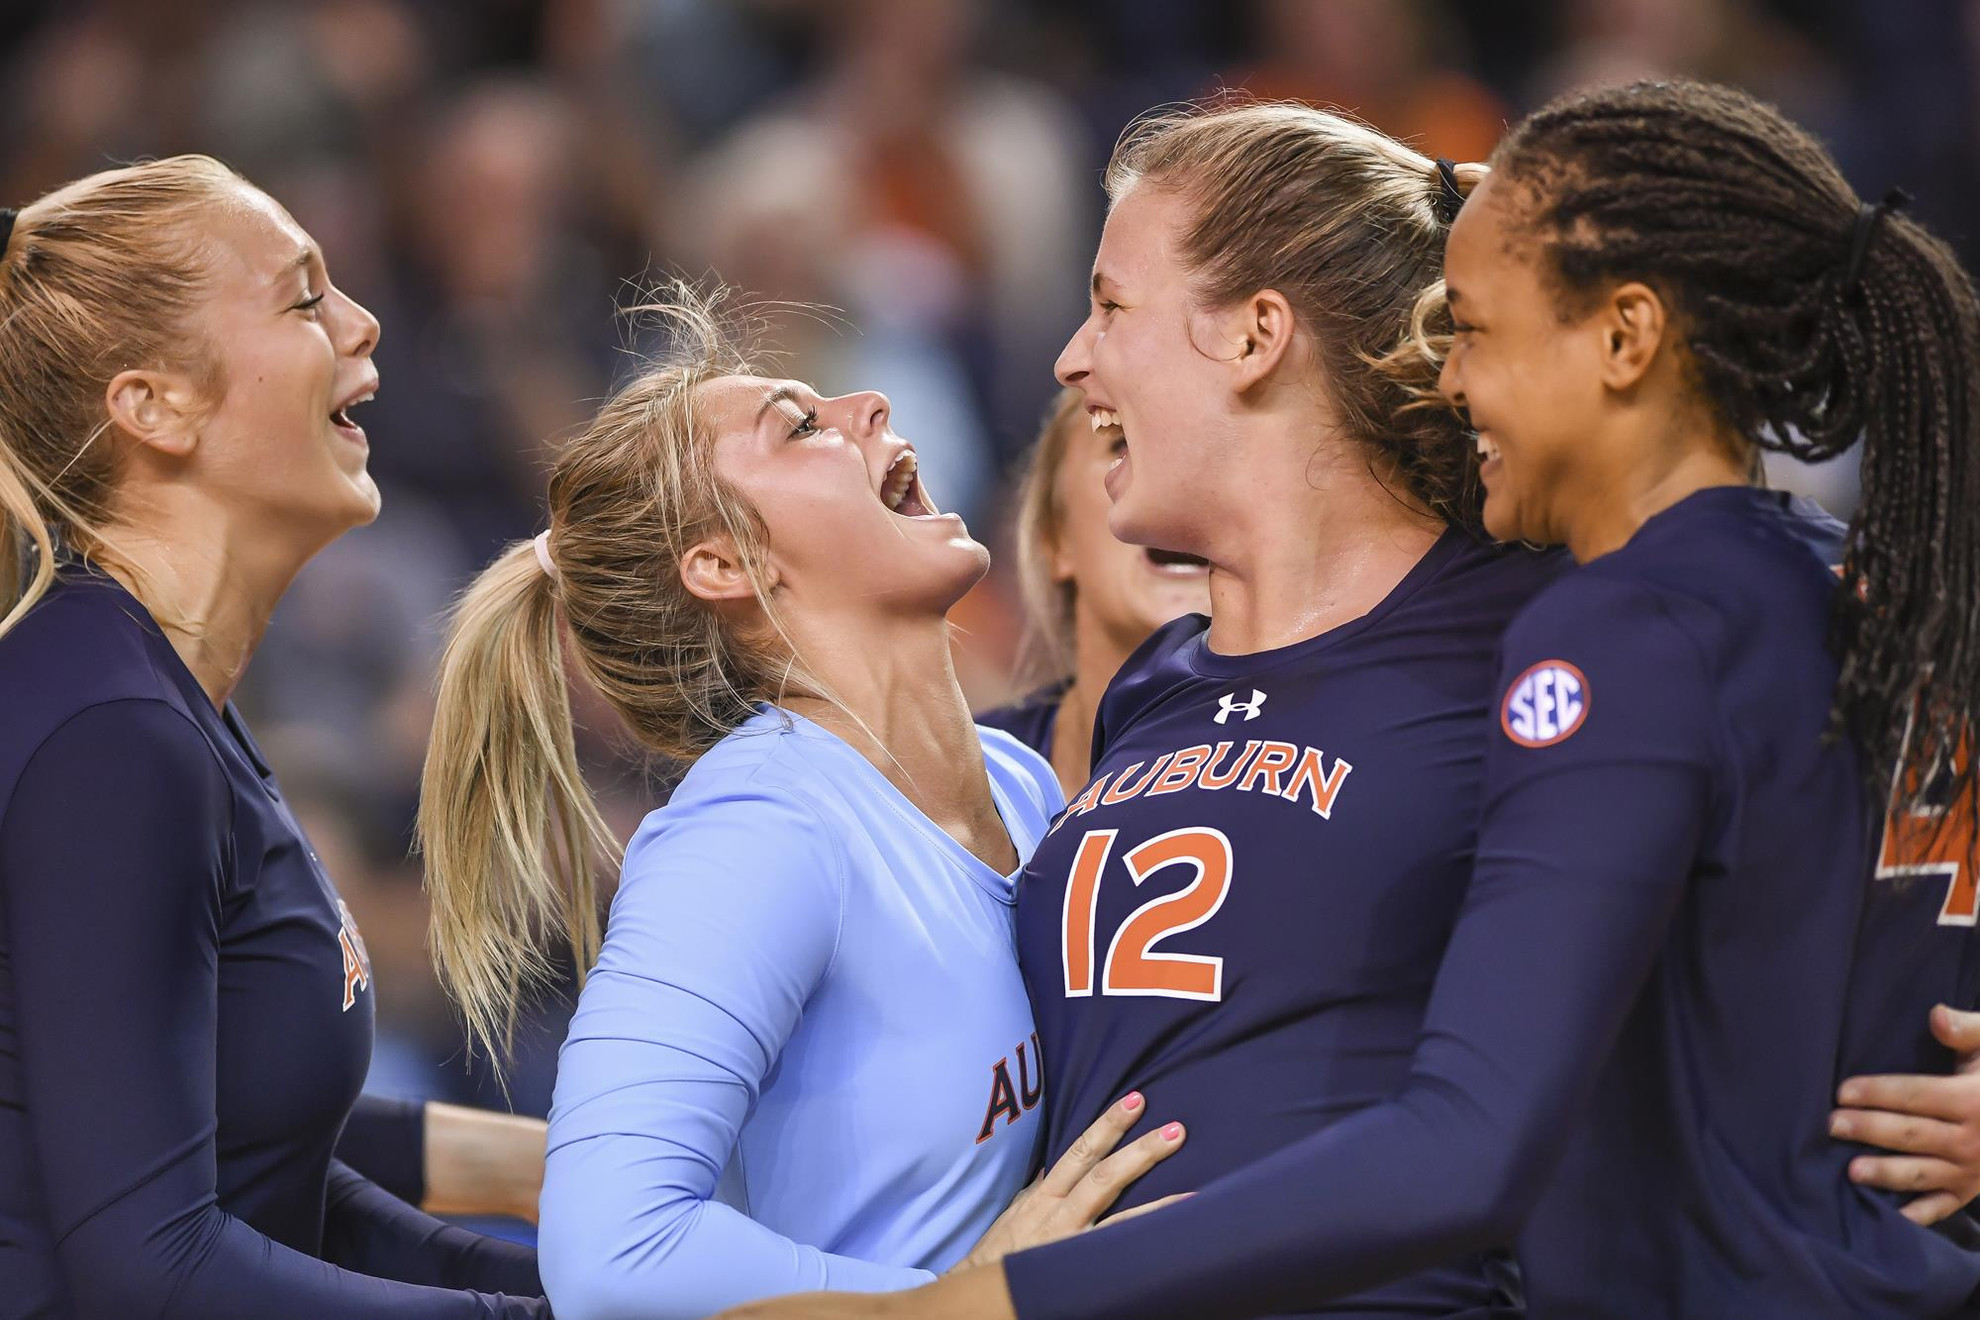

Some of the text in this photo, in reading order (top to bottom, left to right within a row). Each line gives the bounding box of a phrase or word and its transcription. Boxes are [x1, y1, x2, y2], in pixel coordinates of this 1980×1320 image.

[1508, 668, 1583, 741] SEC
[1048, 740, 1352, 837] AUBURN
[1061, 826, 1234, 1002] 12
